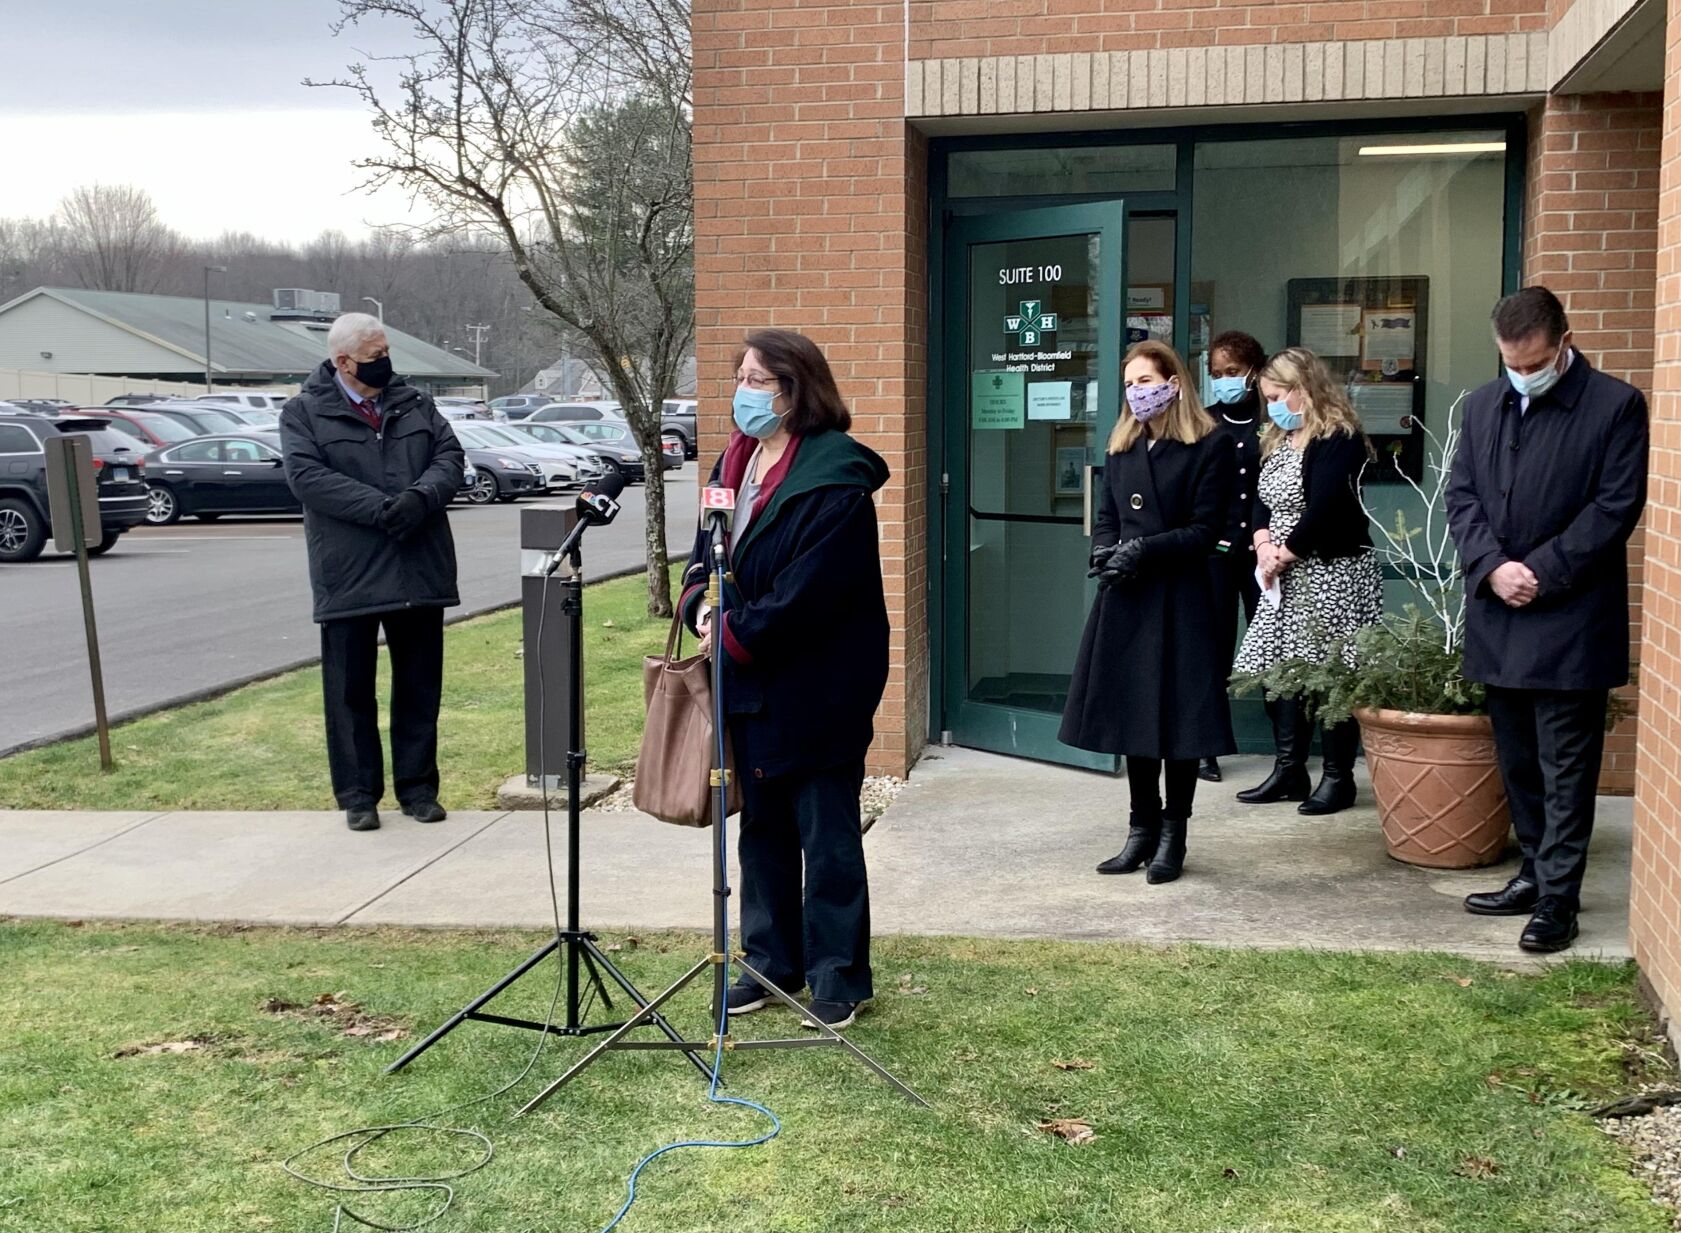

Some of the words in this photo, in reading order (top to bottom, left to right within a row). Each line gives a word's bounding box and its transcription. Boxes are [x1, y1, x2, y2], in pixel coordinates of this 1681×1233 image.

[999, 267, 1033, 284] SUITE
[1038, 265, 1062, 282] 100
[1007, 318, 1020, 330] W
[1041, 316, 1054, 329] H
[1025, 331, 1035, 344] B
[991, 353, 1007, 361] West
[1006, 364, 1029, 372] Health
[1031, 363, 1056, 372] District
[709, 489, 729, 507] 8
[594, 494, 619, 518] CT
